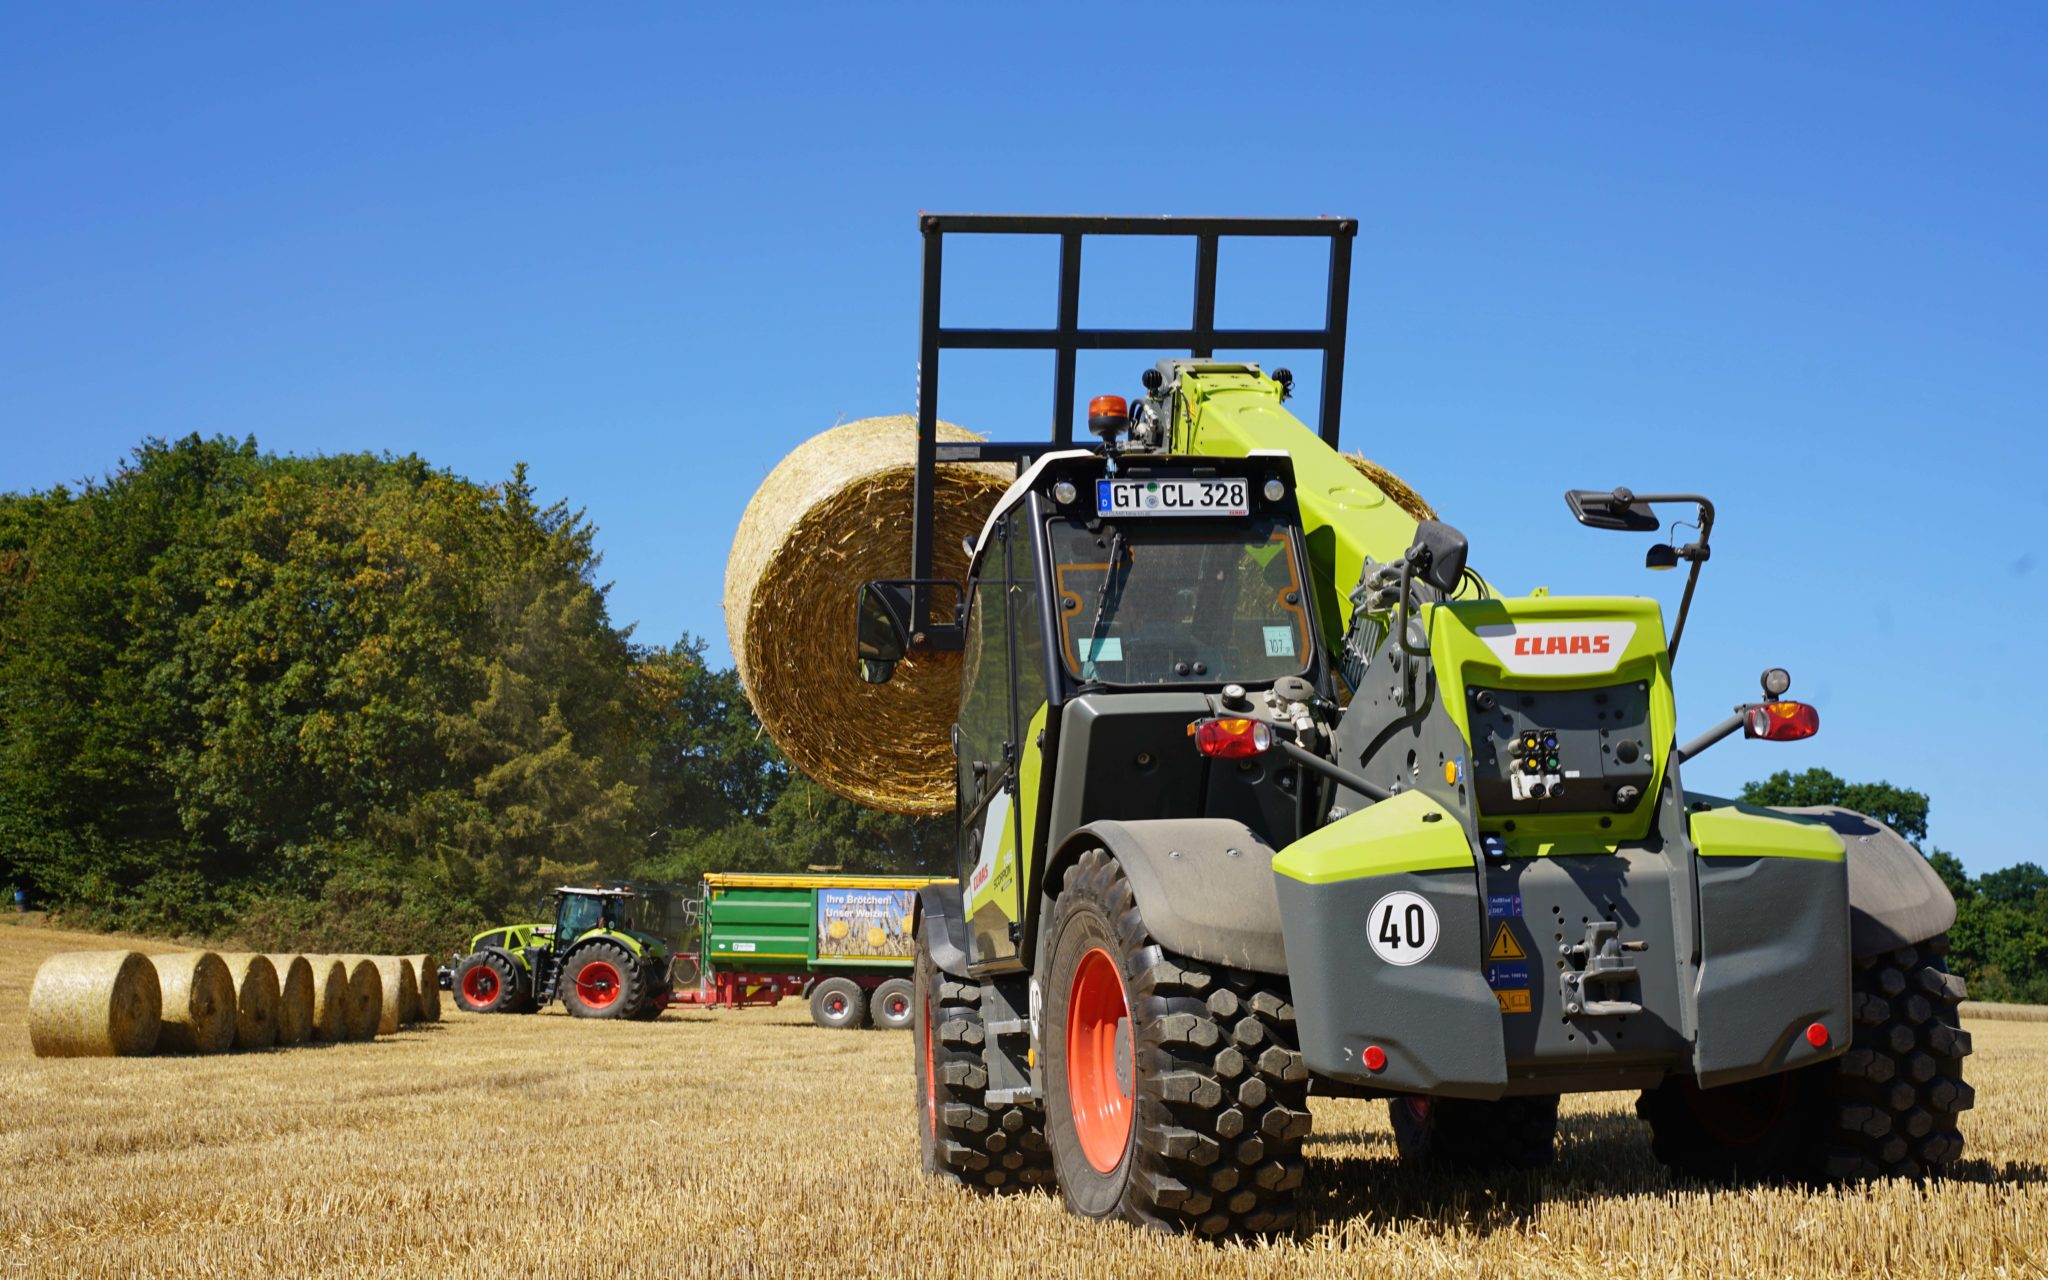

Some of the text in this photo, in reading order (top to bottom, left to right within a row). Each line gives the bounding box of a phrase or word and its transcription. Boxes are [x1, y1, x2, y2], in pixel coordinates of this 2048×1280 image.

[1102, 483, 1244, 508] D GT CL 328
[1514, 635, 1610, 656] CLAAS
[973, 863, 989, 892] CLAAS
[826, 894, 845, 904] Ihre
[826, 908, 853, 918] Unser
[1379, 903, 1425, 949] 40
